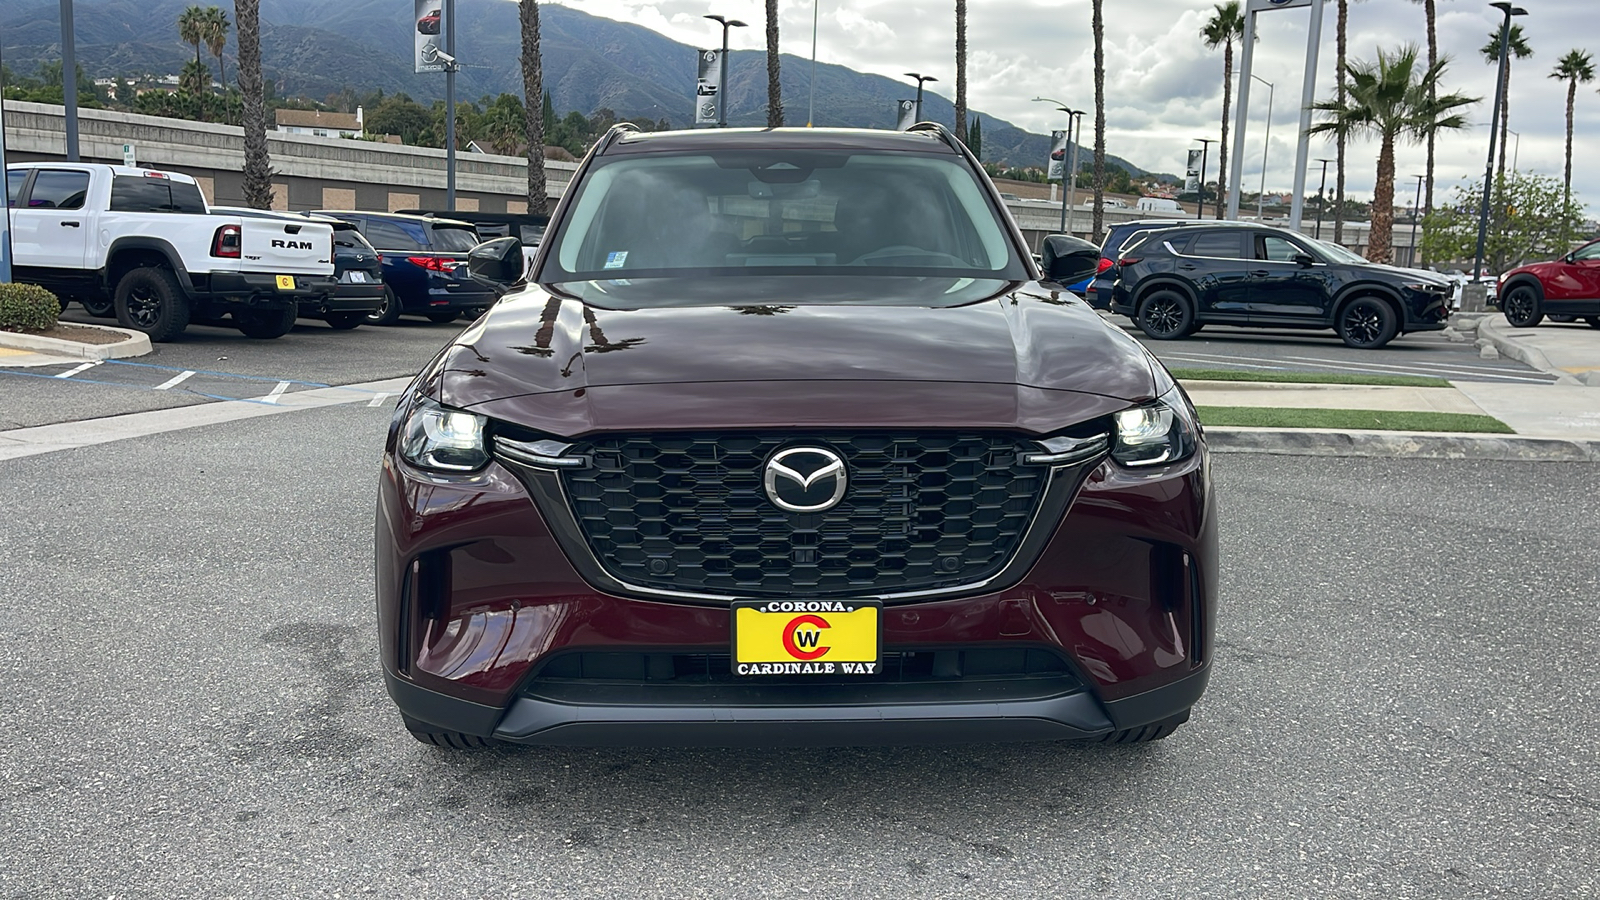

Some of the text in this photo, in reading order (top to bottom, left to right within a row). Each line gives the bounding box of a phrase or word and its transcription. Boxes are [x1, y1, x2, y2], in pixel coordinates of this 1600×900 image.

[272, 239, 312, 250] RAM
[767, 601, 846, 612] CORONA
[797, 631, 821, 648] W
[737, 662, 877, 675] CARDINALE WAY
